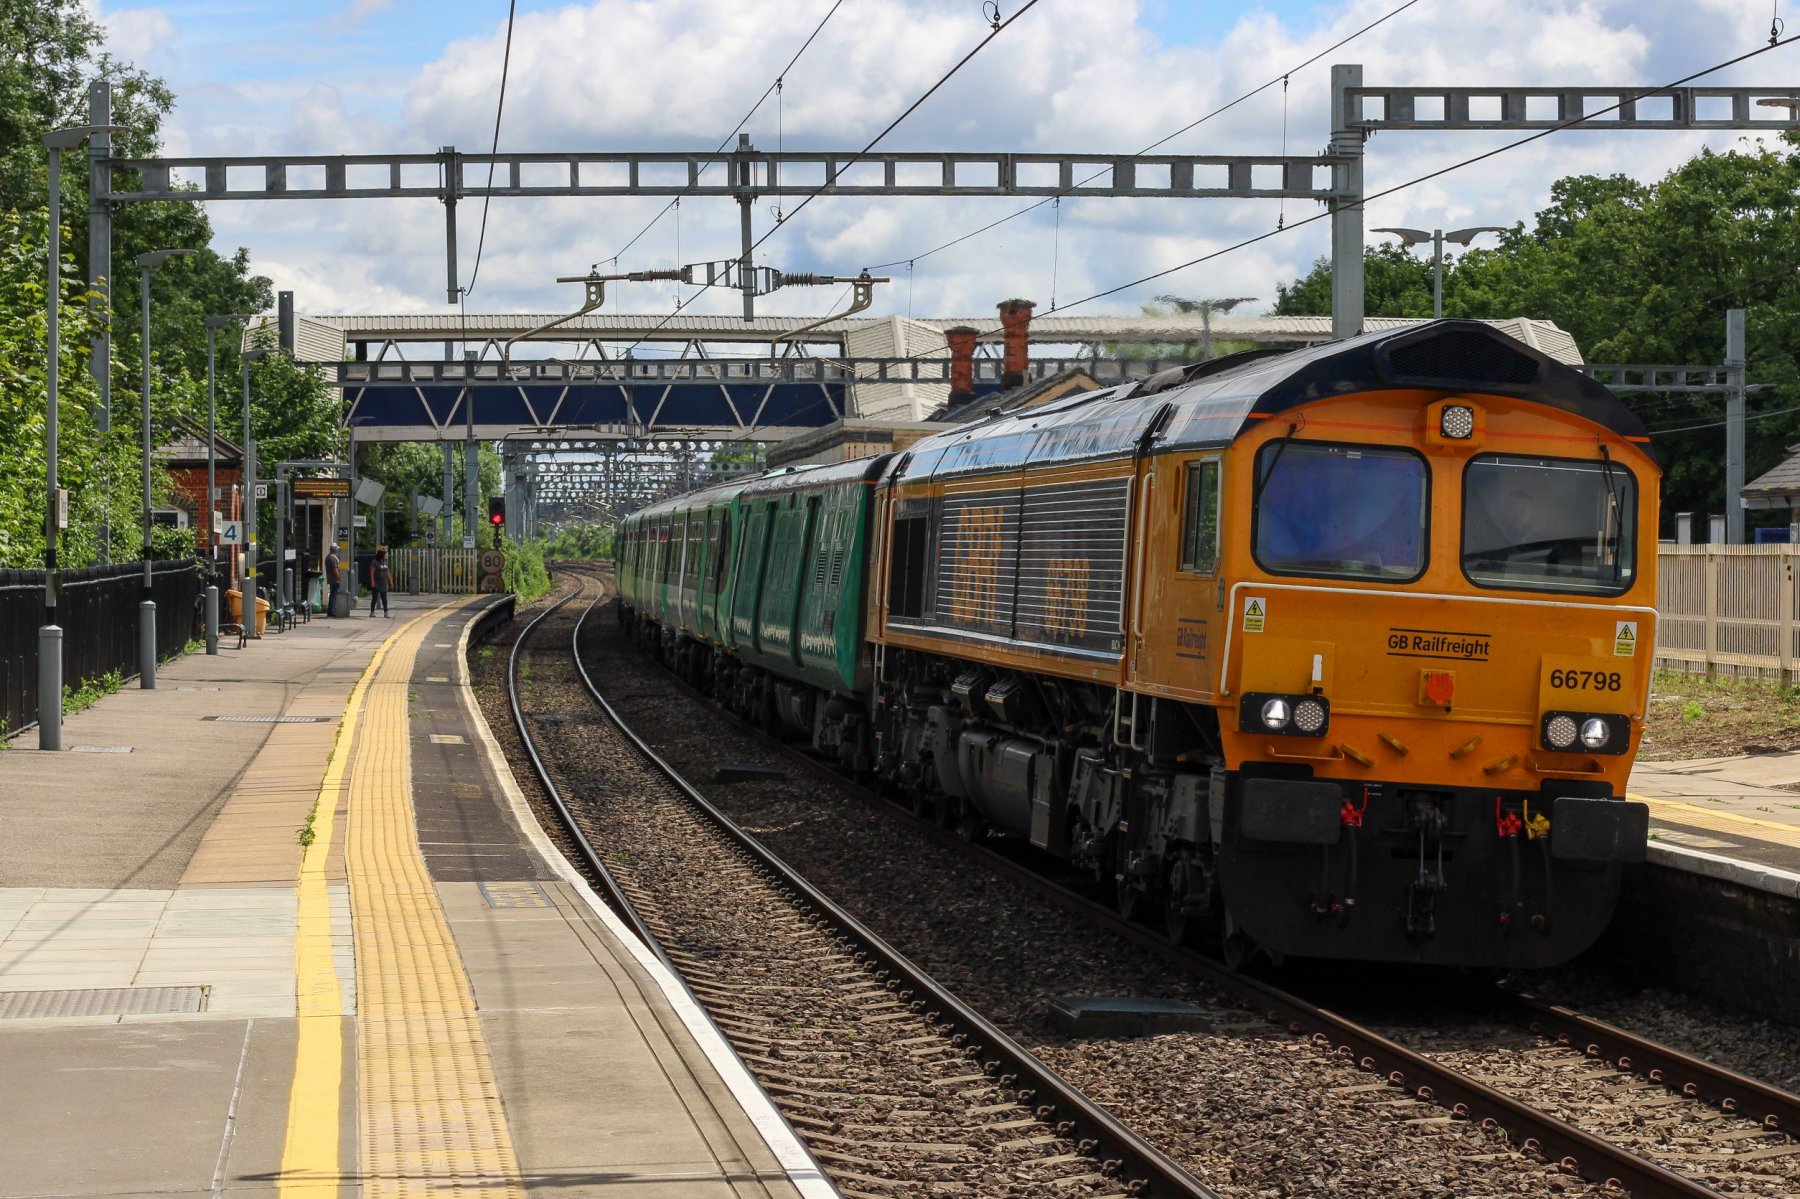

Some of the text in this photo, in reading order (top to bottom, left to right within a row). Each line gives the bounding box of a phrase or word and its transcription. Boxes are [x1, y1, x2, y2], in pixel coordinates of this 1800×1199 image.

[224, 524, 237, 541] 4
[484, 556, 500, 567] 80
[1387, 634, 1490, 658] GB Railfreight
[1550, 669, 1622, 692] 66798
